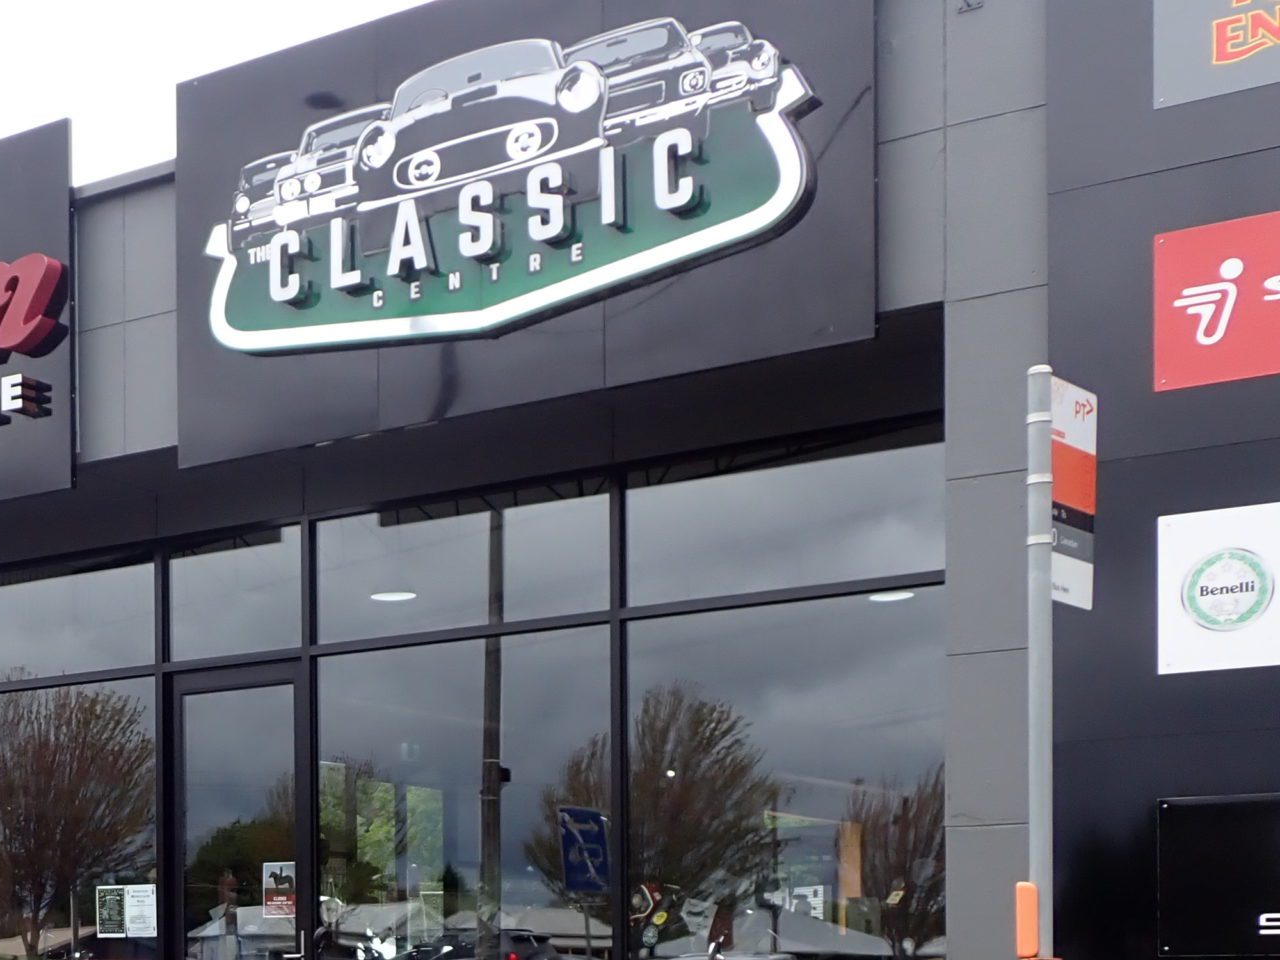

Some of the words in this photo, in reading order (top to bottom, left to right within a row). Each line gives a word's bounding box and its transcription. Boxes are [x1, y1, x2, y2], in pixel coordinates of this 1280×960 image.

[268, 127, 696, 302] CLASSIC
[372, 243, 585, 308] CENTRE
[1200, 580, 1255, 597] Benelli
